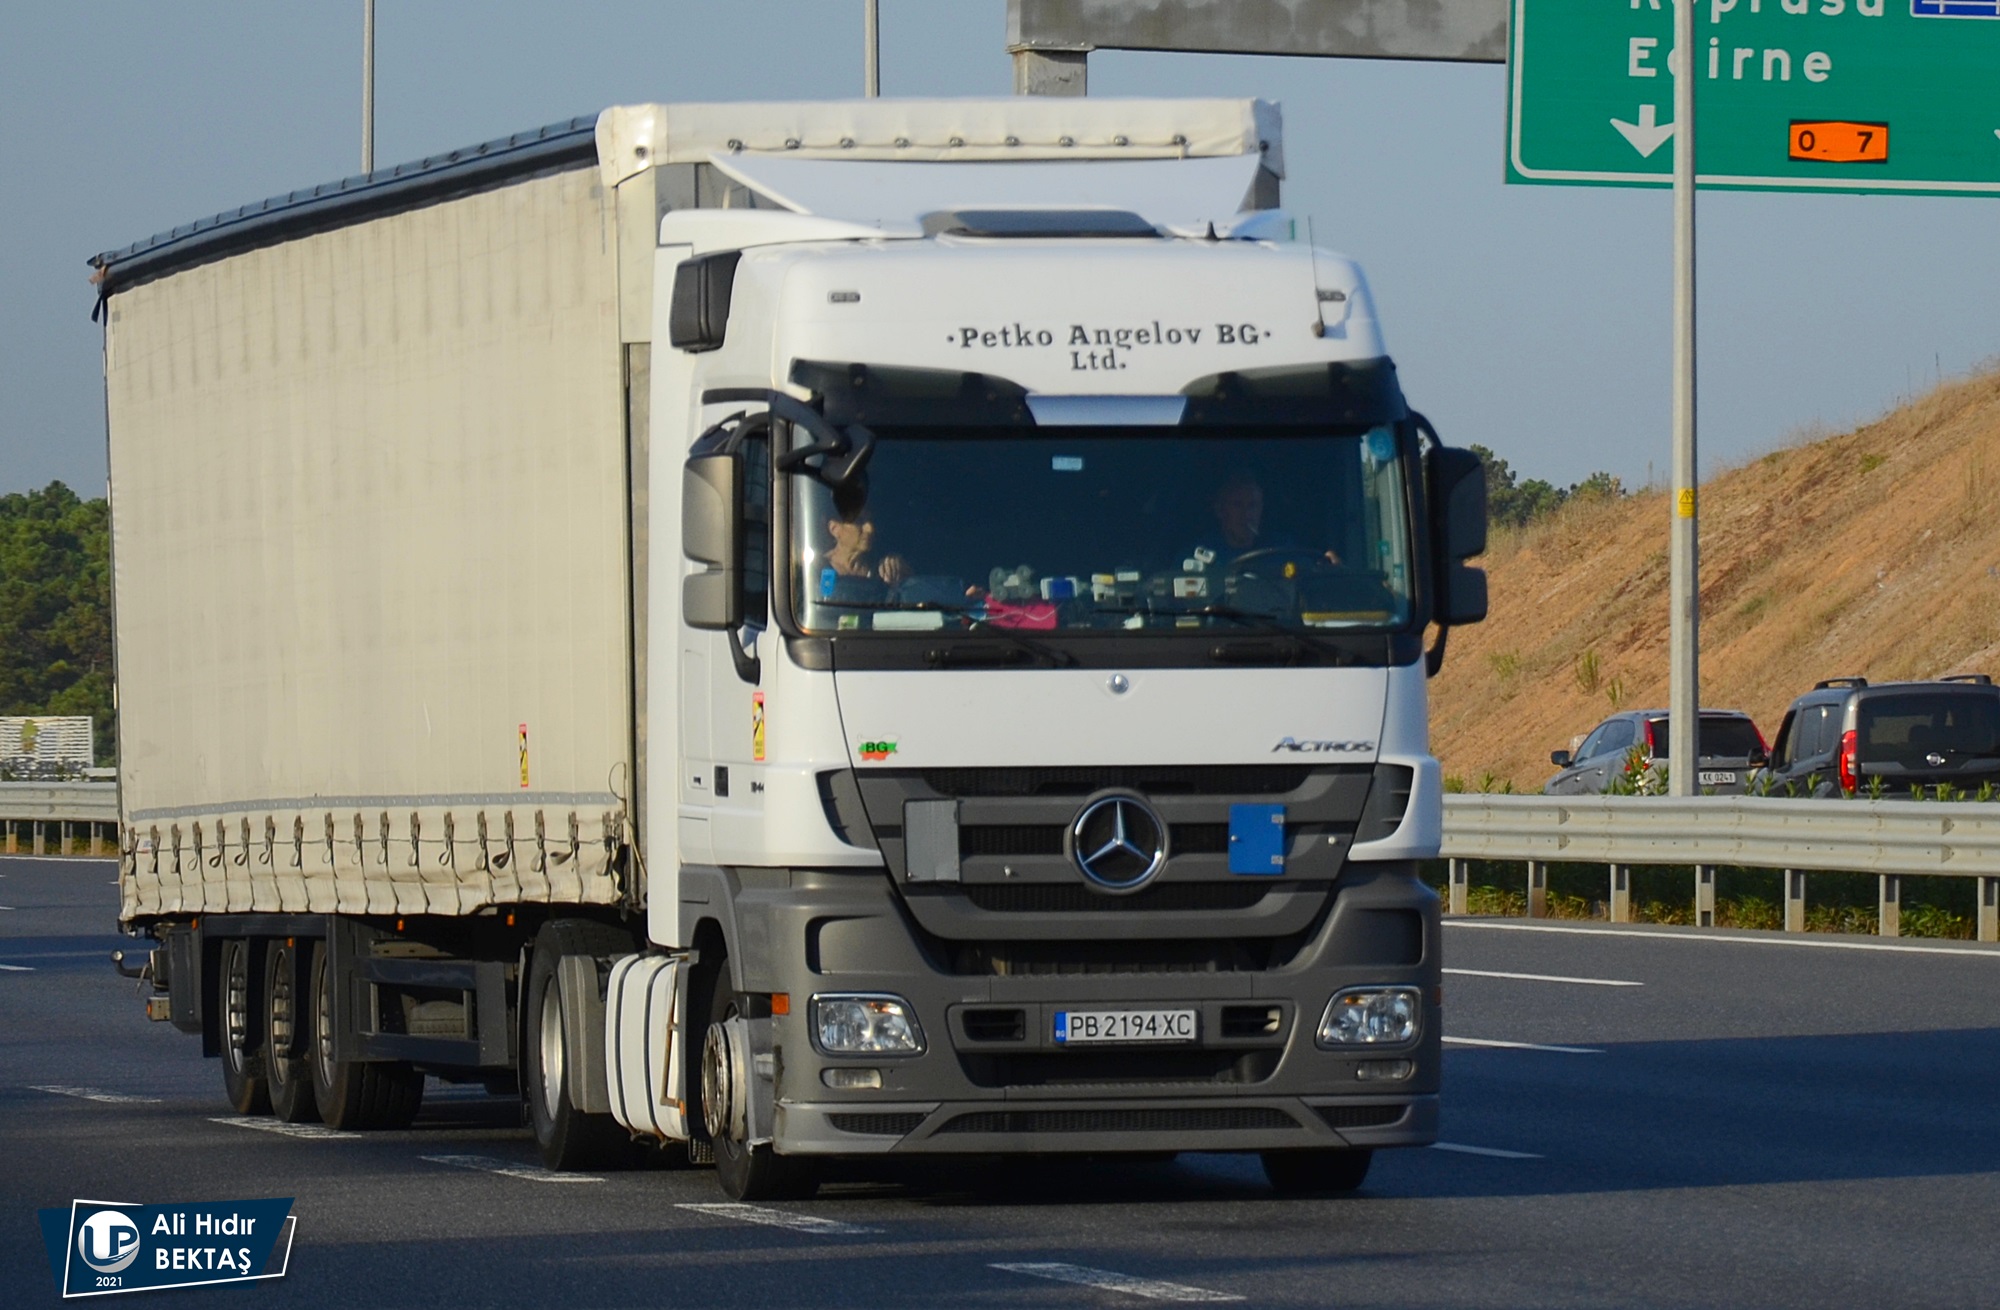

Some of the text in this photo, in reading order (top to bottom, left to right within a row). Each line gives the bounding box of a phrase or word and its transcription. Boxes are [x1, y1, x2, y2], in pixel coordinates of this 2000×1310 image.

[1628, 37, 1832, 82] Eirne
[1856, 131, 1874, 153] 7
[1068, 321, 1202, 351] Angelov
[1070, 350, 1127, 371] Ltd.
[866, 741, 888, 753] BG
[1070, 1014, 1191, 1037] PB 2194 XC
